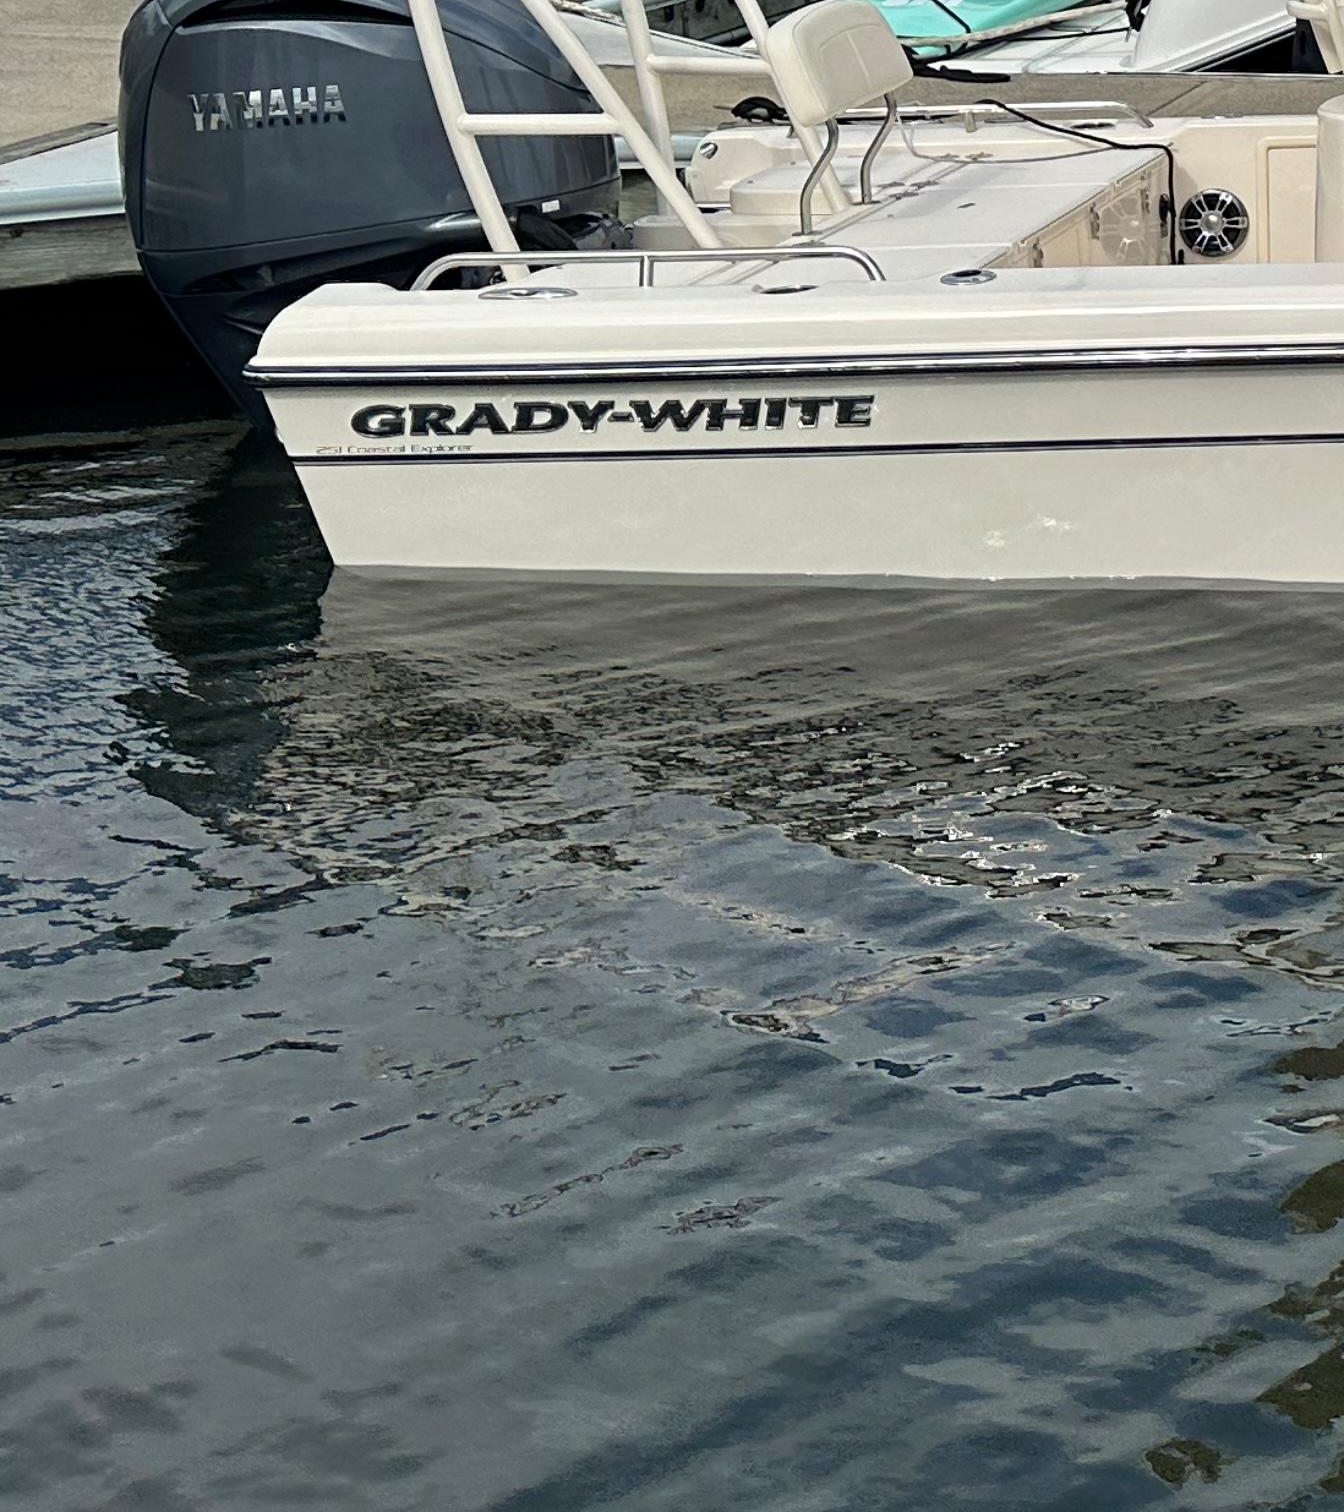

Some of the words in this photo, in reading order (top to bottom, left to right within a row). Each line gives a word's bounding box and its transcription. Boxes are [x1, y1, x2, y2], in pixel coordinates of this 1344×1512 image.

[186, 84, 347, 132] YAMAHA
[350, 394, 876, 439] GRADY-WHITE
[346, 444, 406, 454] Coastal
[410, 443, 475, 454] Explorer
